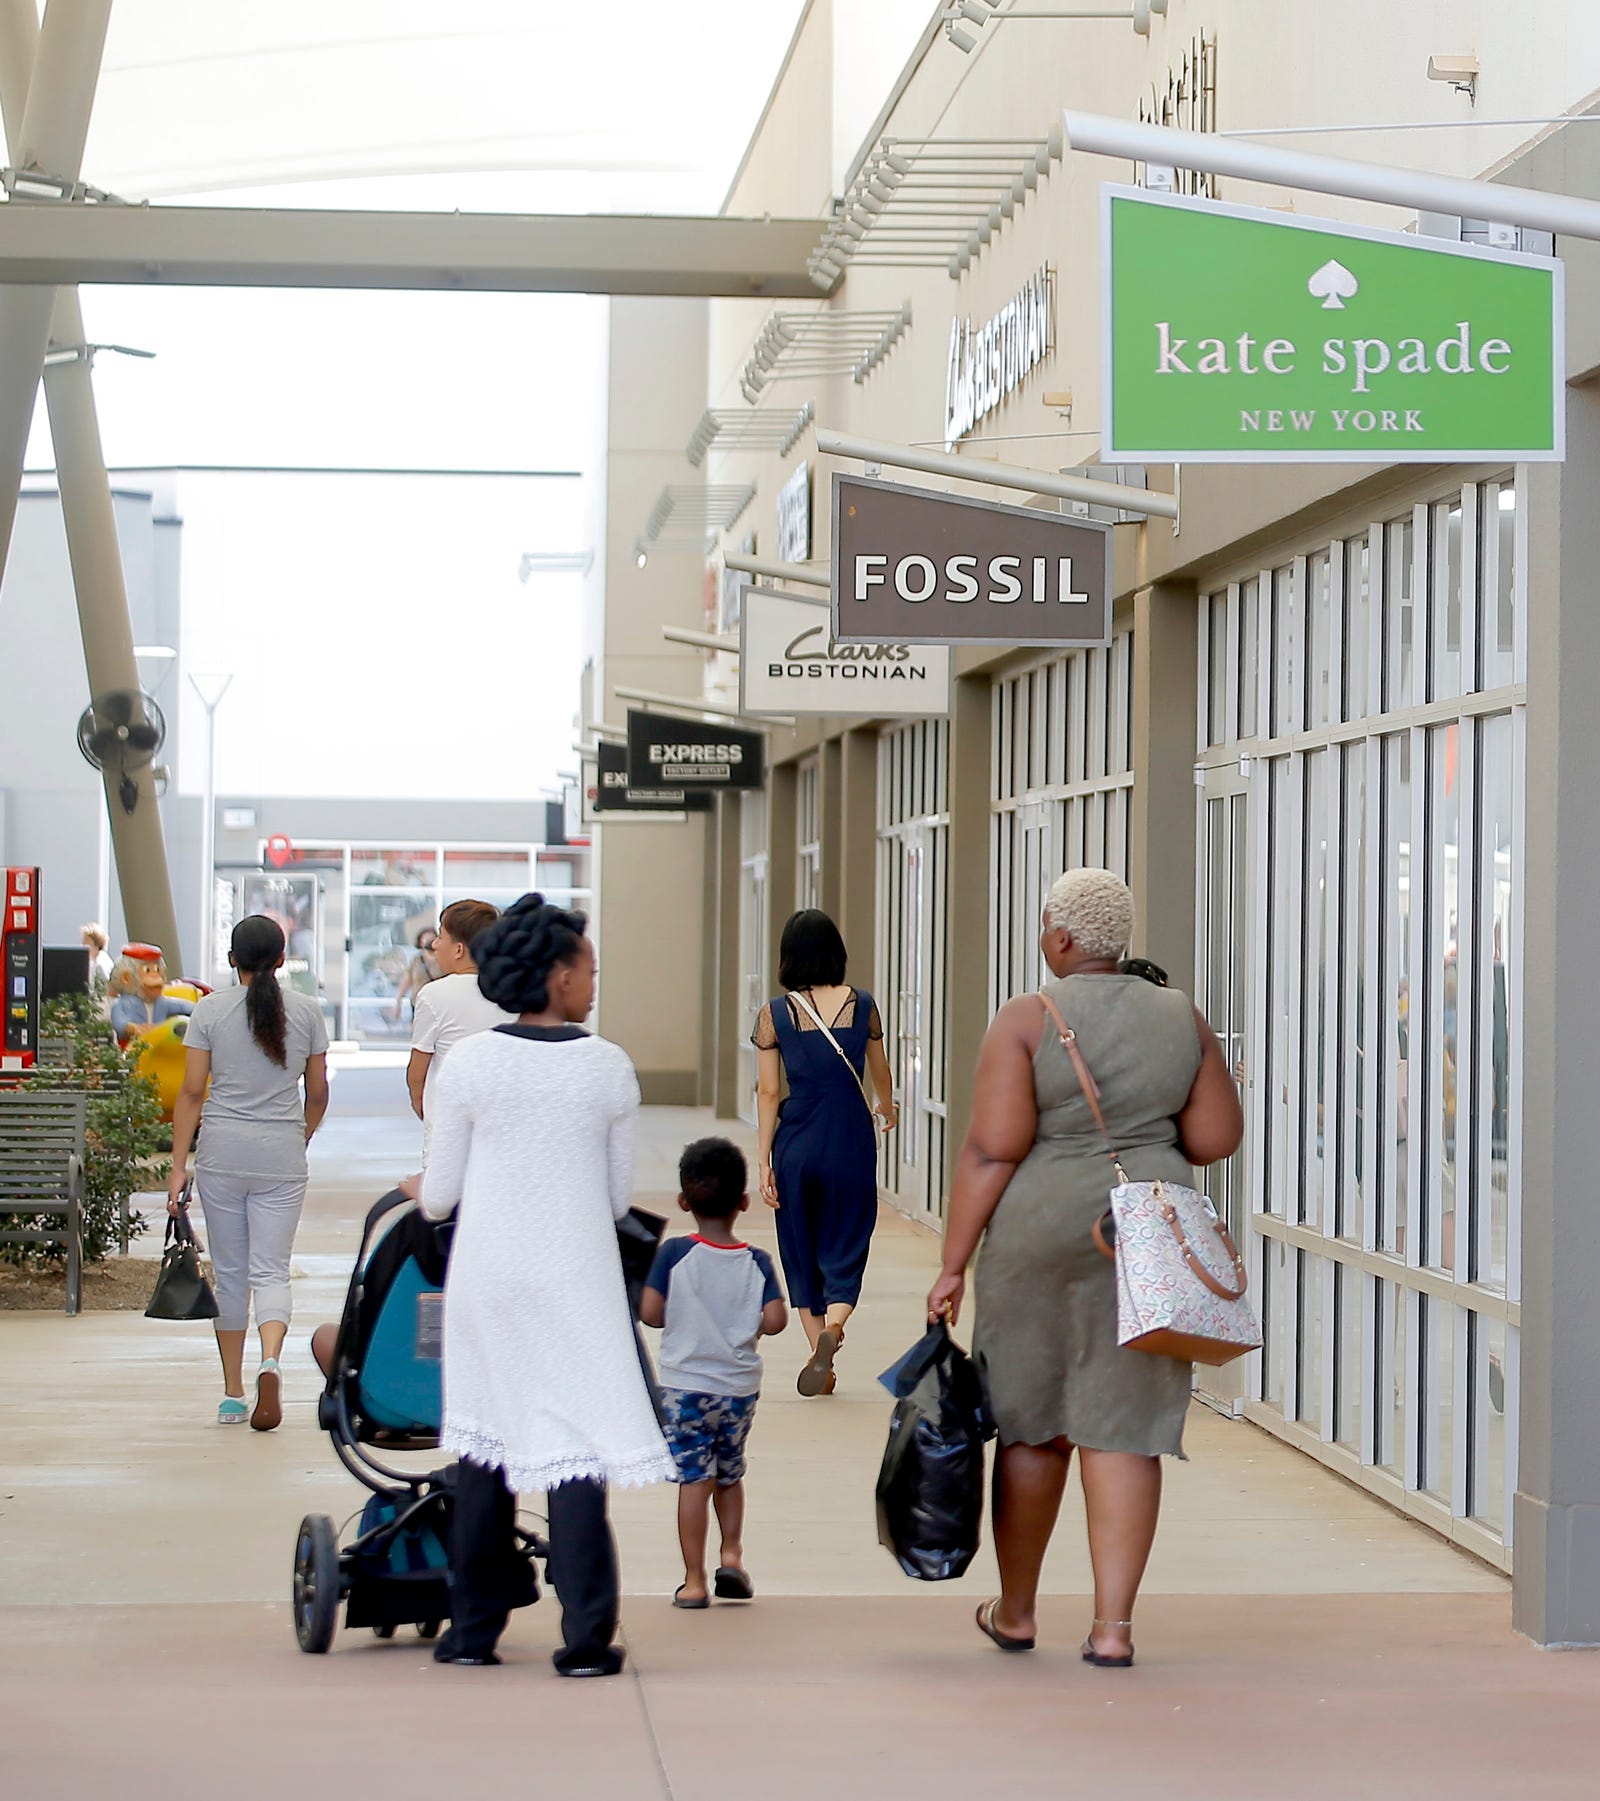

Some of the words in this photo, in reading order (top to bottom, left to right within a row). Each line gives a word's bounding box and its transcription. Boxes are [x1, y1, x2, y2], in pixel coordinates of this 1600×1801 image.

[1154, 321, 1296, 375] kate
[1322, 320, 1513, 393] spade
[1239, 409, 1317, 432] NEW
[1331, 409, 1425, 432] YORK
[854, 554, 1089, 603] FOSSIL
[768, 664, 926, 680] BOSTONIAN
[649, 744, 743, 763] EXPRESS
